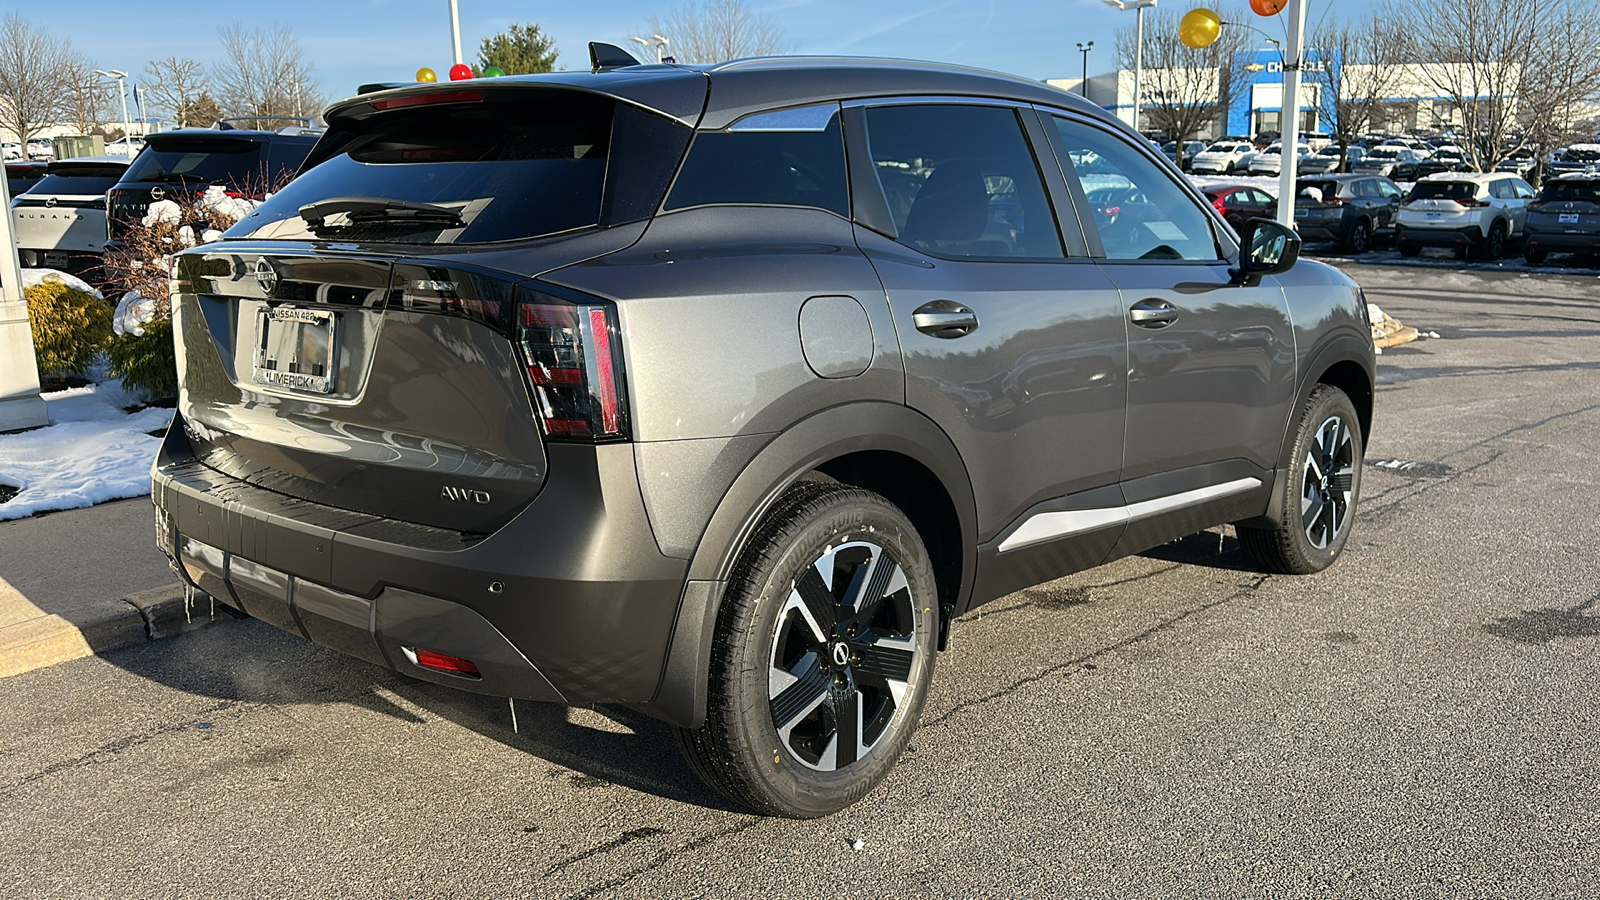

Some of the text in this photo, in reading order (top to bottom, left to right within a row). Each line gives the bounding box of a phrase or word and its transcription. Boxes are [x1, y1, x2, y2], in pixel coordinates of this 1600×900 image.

[268, 372, 310, 388] LIMERICK
[440, 485, 491, 504] AWD
[776, 511, 864, 592] BRIDGESTONE
